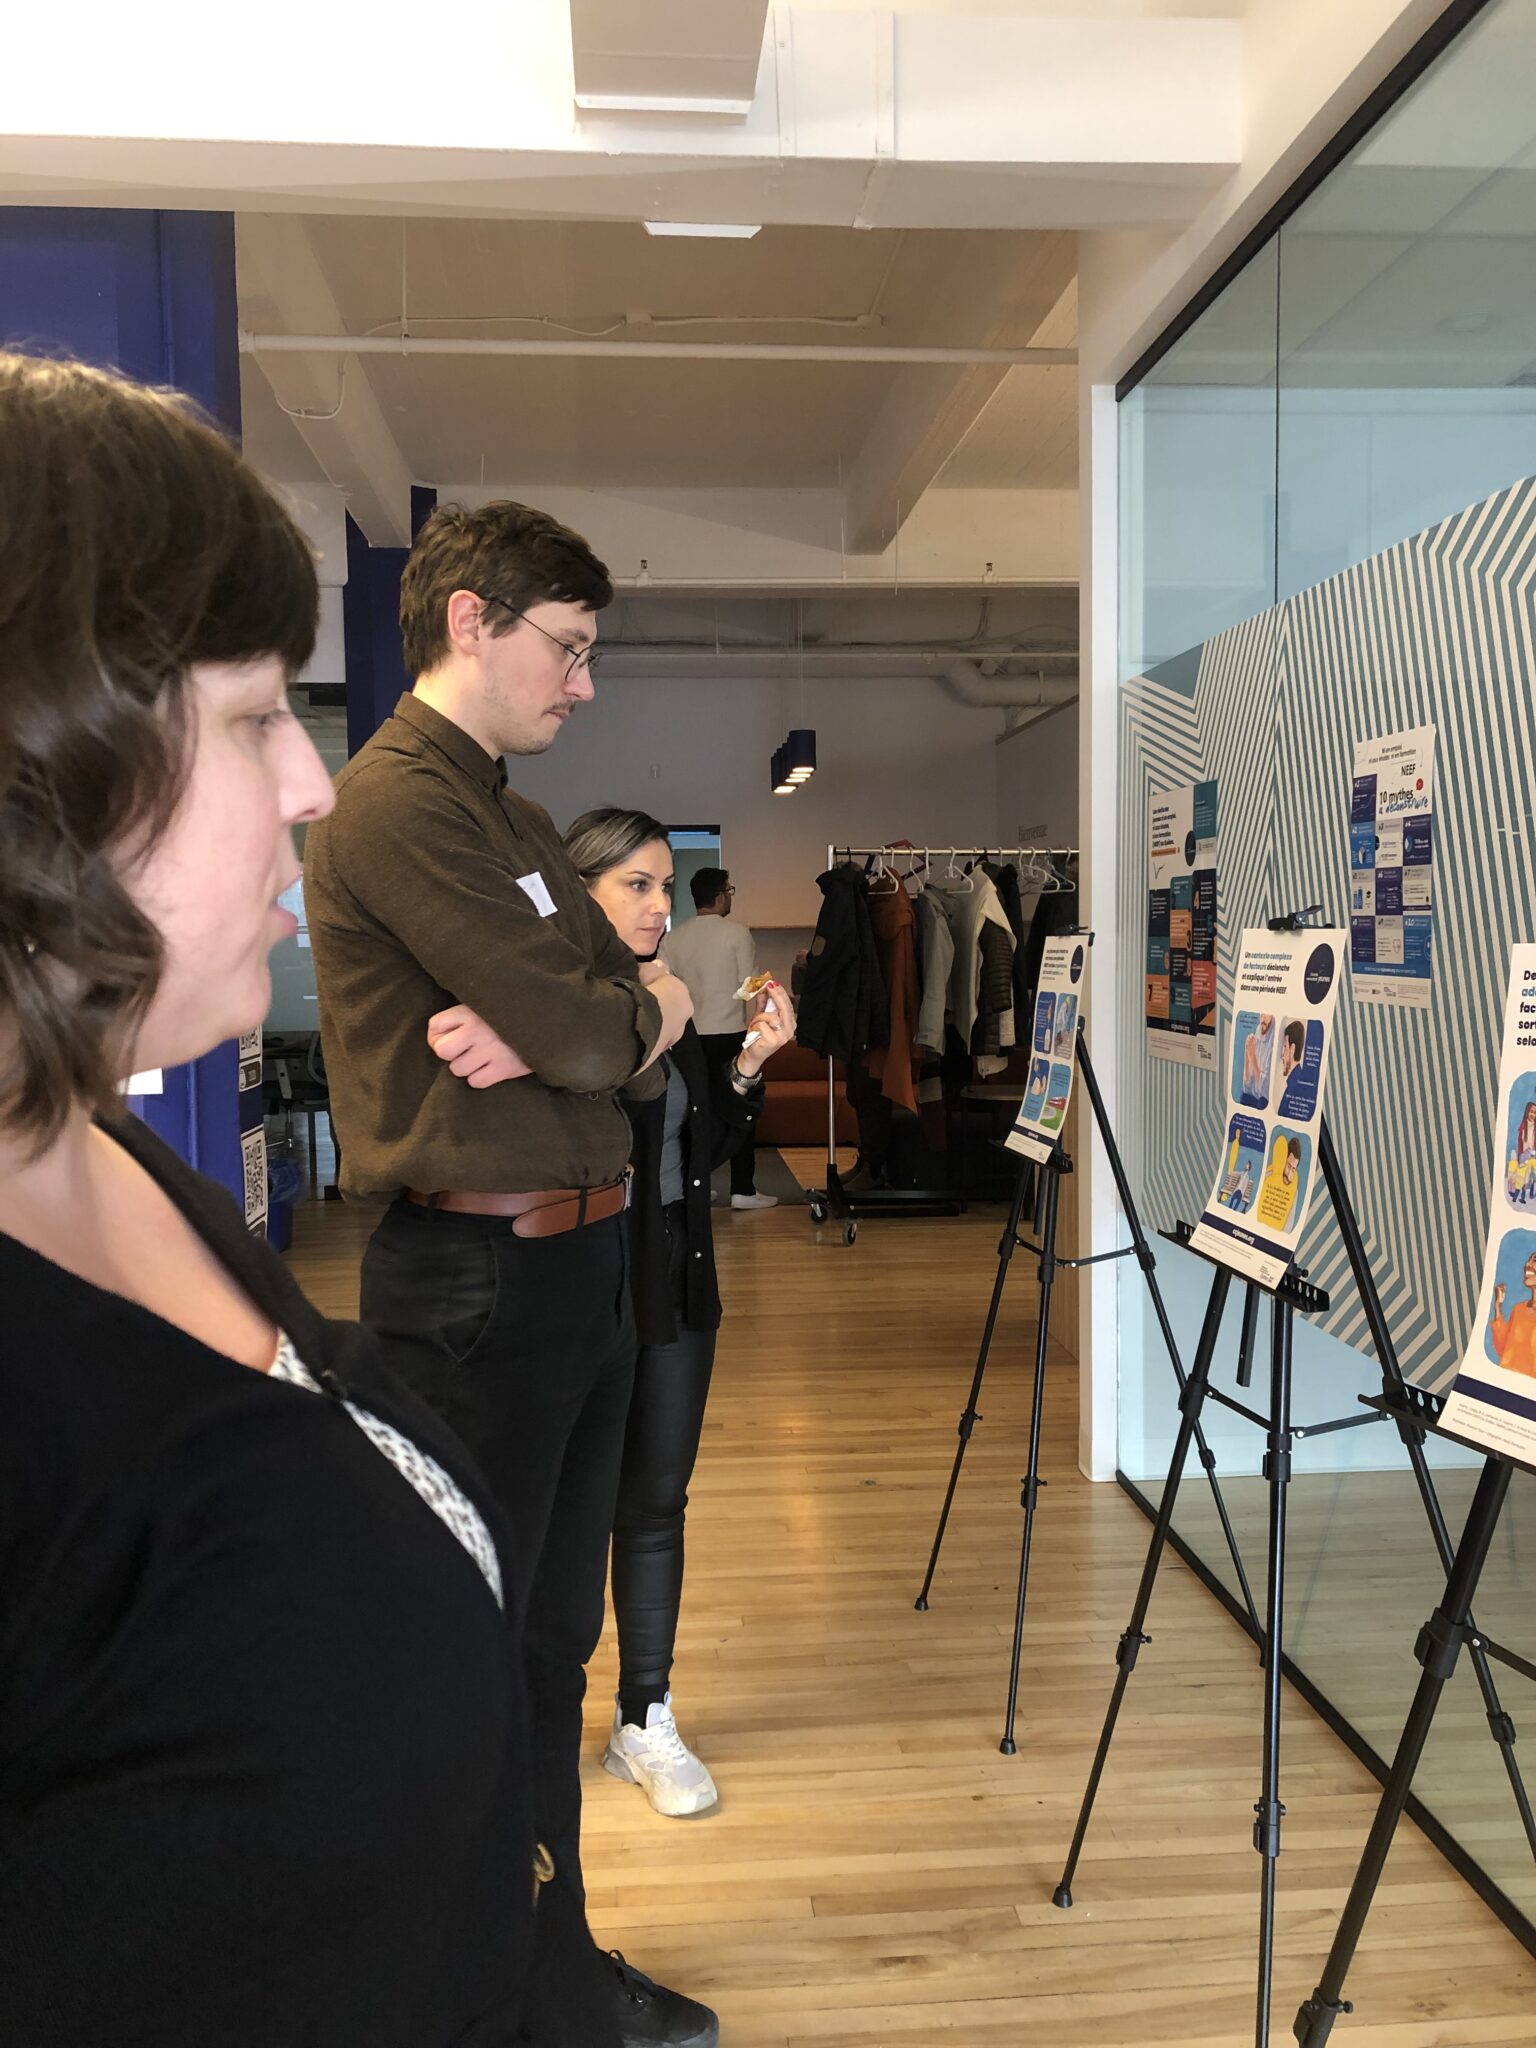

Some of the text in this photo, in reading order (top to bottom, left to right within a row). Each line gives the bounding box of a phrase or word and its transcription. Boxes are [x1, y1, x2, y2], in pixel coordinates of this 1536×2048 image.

[1401, 764, 1416, 776] NEEF
[1380, 791, 1387, 805] 10
[1388, 787, 1413, 805] mythes
[1193, 890, 1200, 910] 4
[1186, 930, 1192, 951] 3
[1251, 952, 1270, 960] contexte
[1270, 952, 1292, 962] complexe
[1249, 962, 1266, 970] facteurs
[1267, 962, 1290, 971] déclenche
[1247, 973, 1264, 983] explique
[1148, 983, 1153, 1002] 7
[1259, 986, 1275, 994] période
[1521, 986, 1536, 997] ad
